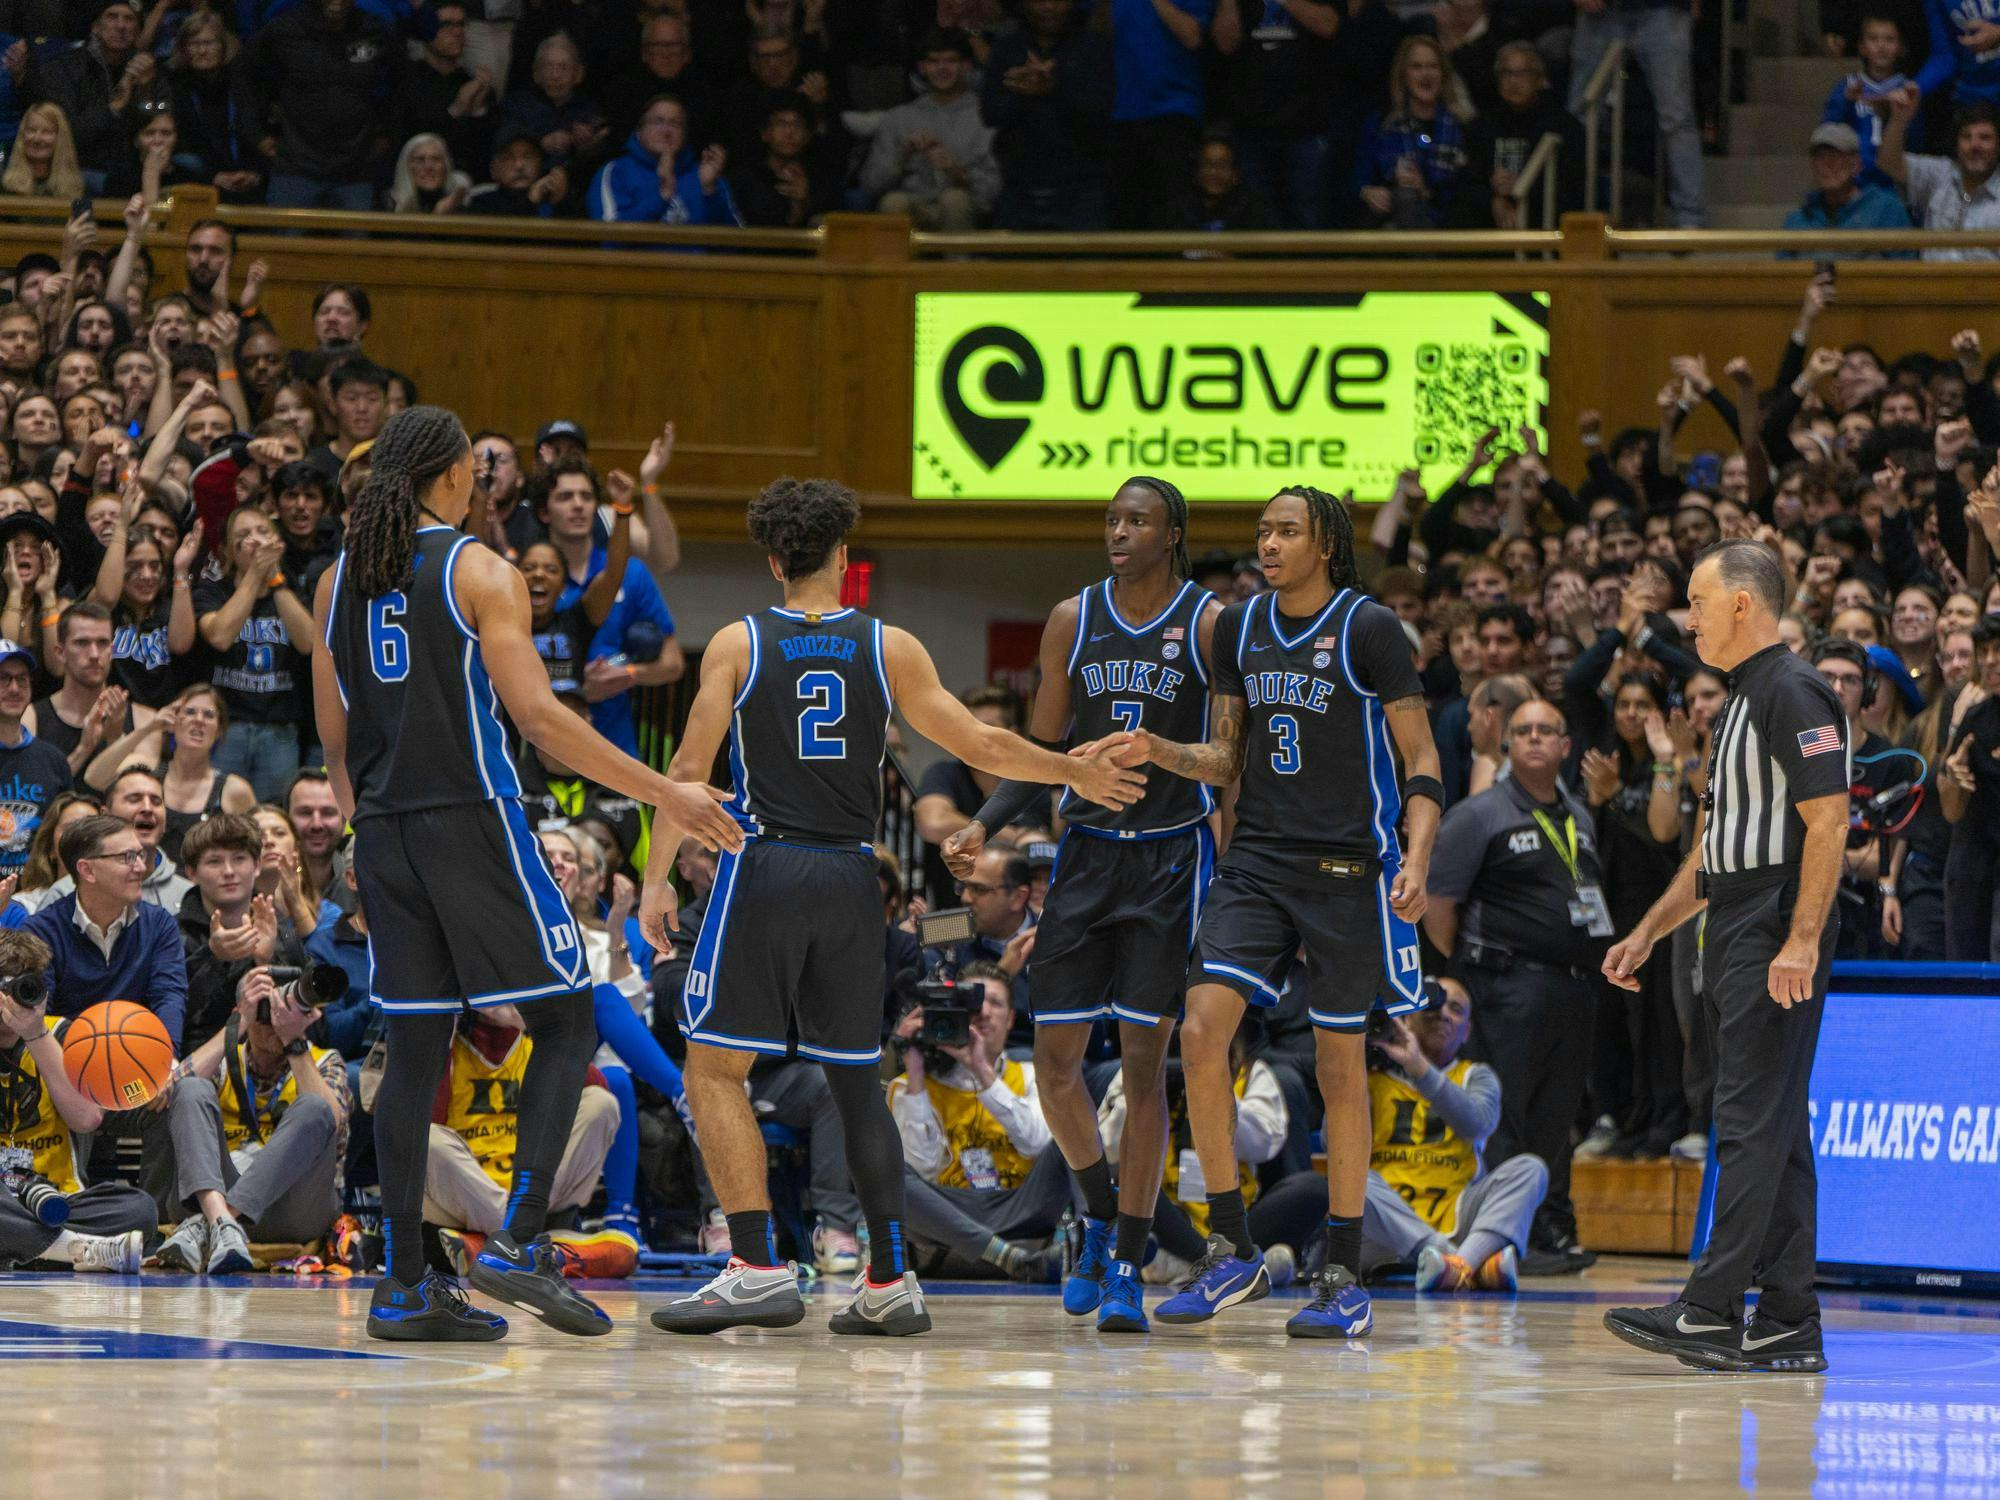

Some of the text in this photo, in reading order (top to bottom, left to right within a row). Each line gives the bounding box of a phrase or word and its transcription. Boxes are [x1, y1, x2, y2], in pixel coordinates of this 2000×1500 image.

[1070, 345, 1389, 413] wave
[1106, 427, 1346, 468] rideshare
[367, 589, 410, 683] 6
[533, 633, 570, 658] KE
[778, 635, 857, 663] BOOZER
[1081, 660, 1185, 702] DUKE
[1244, 672, 1335, 713] DUKE
[797, 671, 846, 759] 2
[1112, 701, 1143, 733] 7
[1269, 714, 1301, 774] 3
[549, 923, 575, 952] D
[688, 970, 707, 997] D
[1818, 1102, 1944, 1160] ALWAYS
